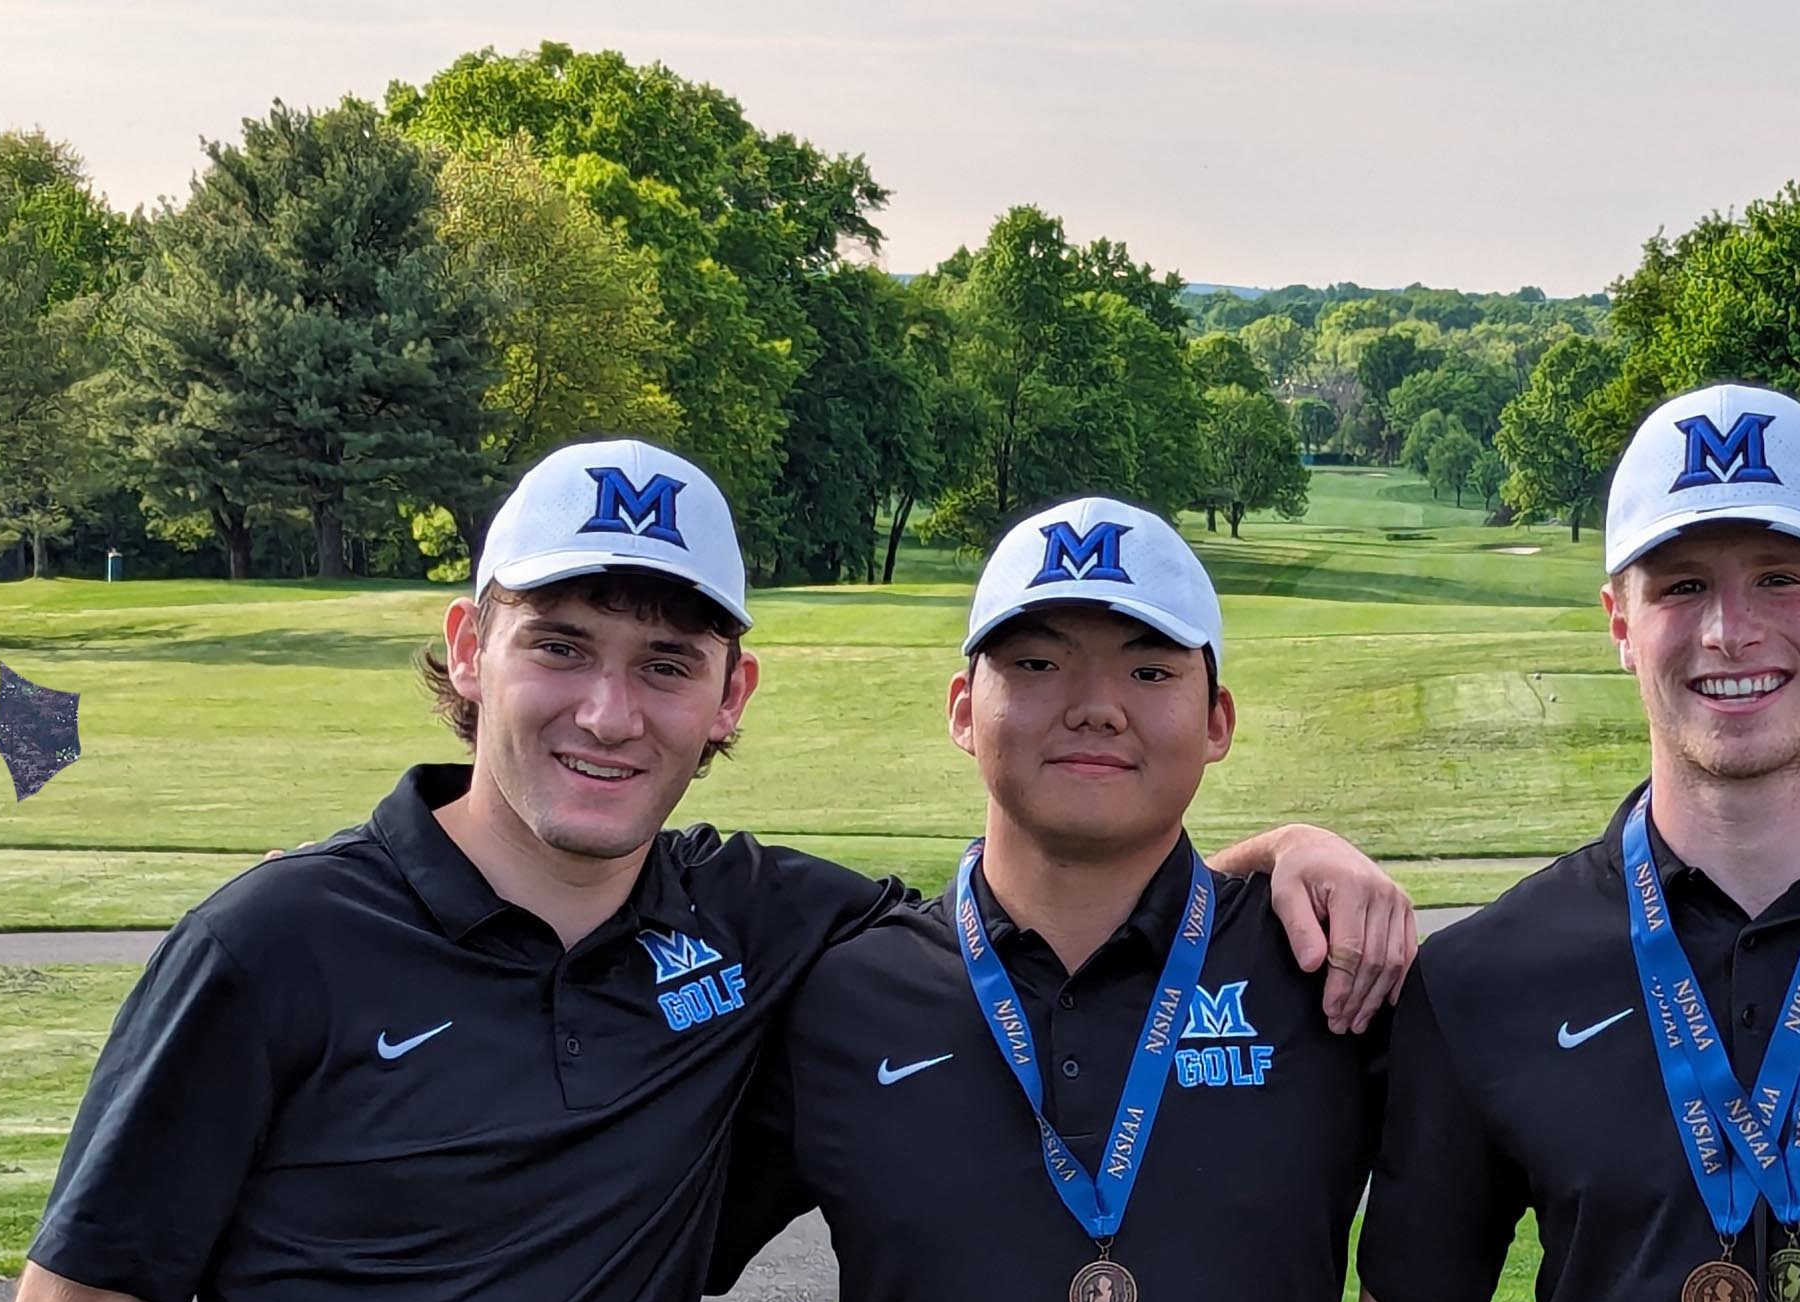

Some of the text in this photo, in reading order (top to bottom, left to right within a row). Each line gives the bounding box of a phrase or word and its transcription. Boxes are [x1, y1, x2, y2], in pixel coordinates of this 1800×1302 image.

[1668, 412, 1784, 494] M
[575, 466, 690, 552] M
[1024, 521, 1136, 590] M
[1183, 883, 1209, 945] NJSIAA
[1634, 860, 1664, 931] NJSIAA
[636, 929, 724, 984] M
[656, 963, 746, 1032] GOLF
[993, 998, 1030, 1064] NJSIAA
[1144, 986, 1182, 1055] NJSIAA
[1180, 980, 1258, 1039] M
[1673, 978, 1714, 1051] NJSIAA
[1174, 1046, 1274, 1088] GOLF
[1107, 1105, 1144, 1180] NJSIAA
[1682, 1098, 1723, 1175] NJSIAA
[1724, 1098, 1778, 1170] NJSIAA
